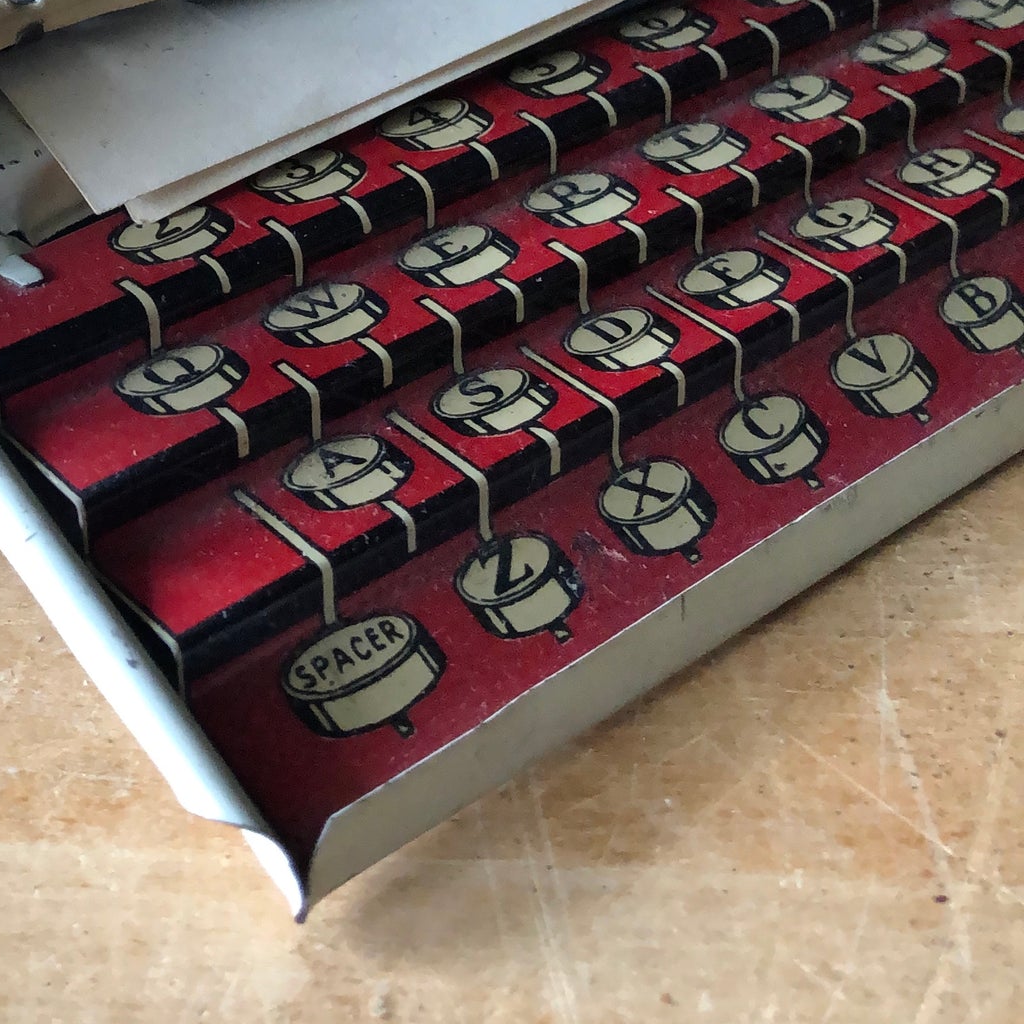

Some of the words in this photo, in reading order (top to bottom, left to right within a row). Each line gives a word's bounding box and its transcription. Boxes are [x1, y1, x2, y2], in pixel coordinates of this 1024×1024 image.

[285, 159, 316, 179] 3
[408, 106, 450, 127] 4
[285, 283, 338, 319] W
[425, 235, 469, 261] E
[551, 180, 602, 207] R
[319, 448, 367, 478] A
[458, 377, 504, 407] S
[582, 317, 632, 344] D
[916, 151, 961, 176] H
[294, 619, 405, 689] SPACER
[476, 539, 534, 596] Z
[613, 459, 676, 516] X
[742, 400, 784, 440] C
[847, 338, 887, 373] V
[954, 282, 997, 318] B
